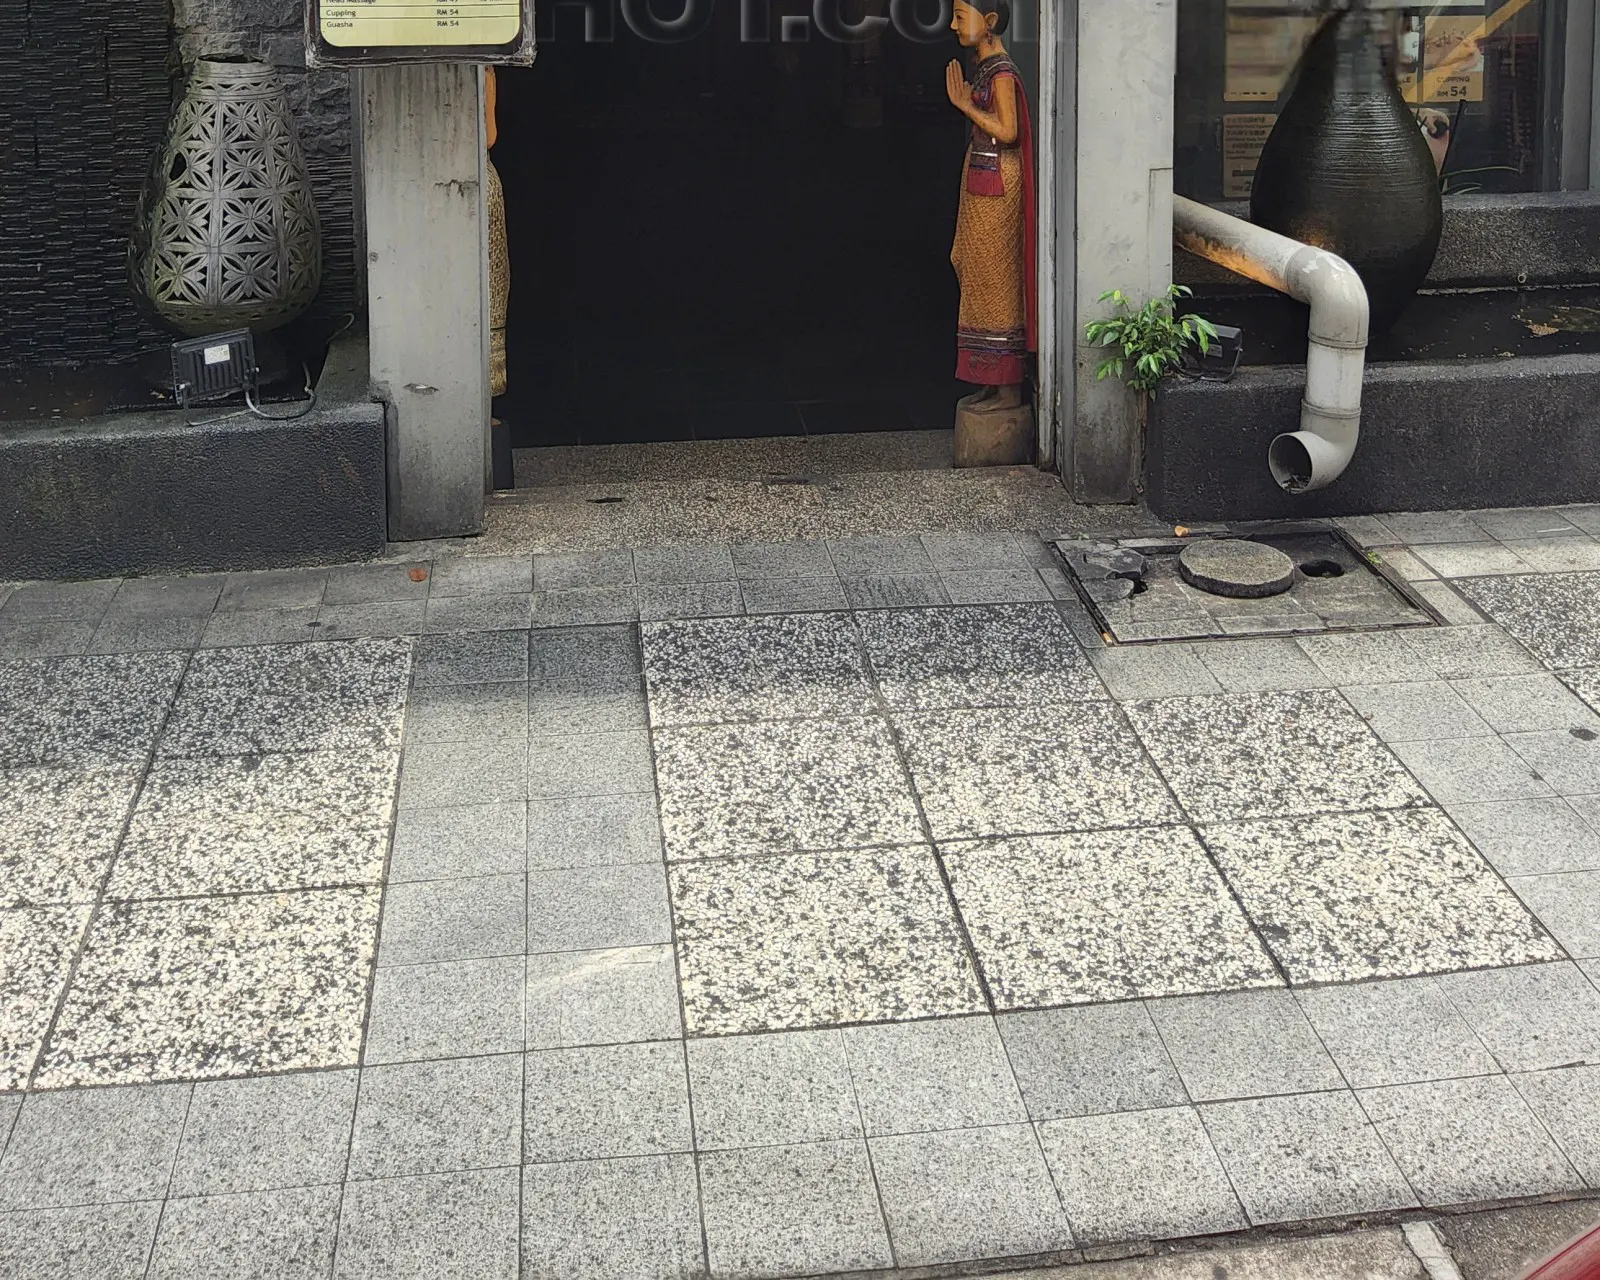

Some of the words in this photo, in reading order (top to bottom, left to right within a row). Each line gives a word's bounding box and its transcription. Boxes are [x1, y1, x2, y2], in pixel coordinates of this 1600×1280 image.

[436, 8, 448, 16] RM
[449, 8, 460, 16] 54
[1450, 85, 1468, 96] 54
